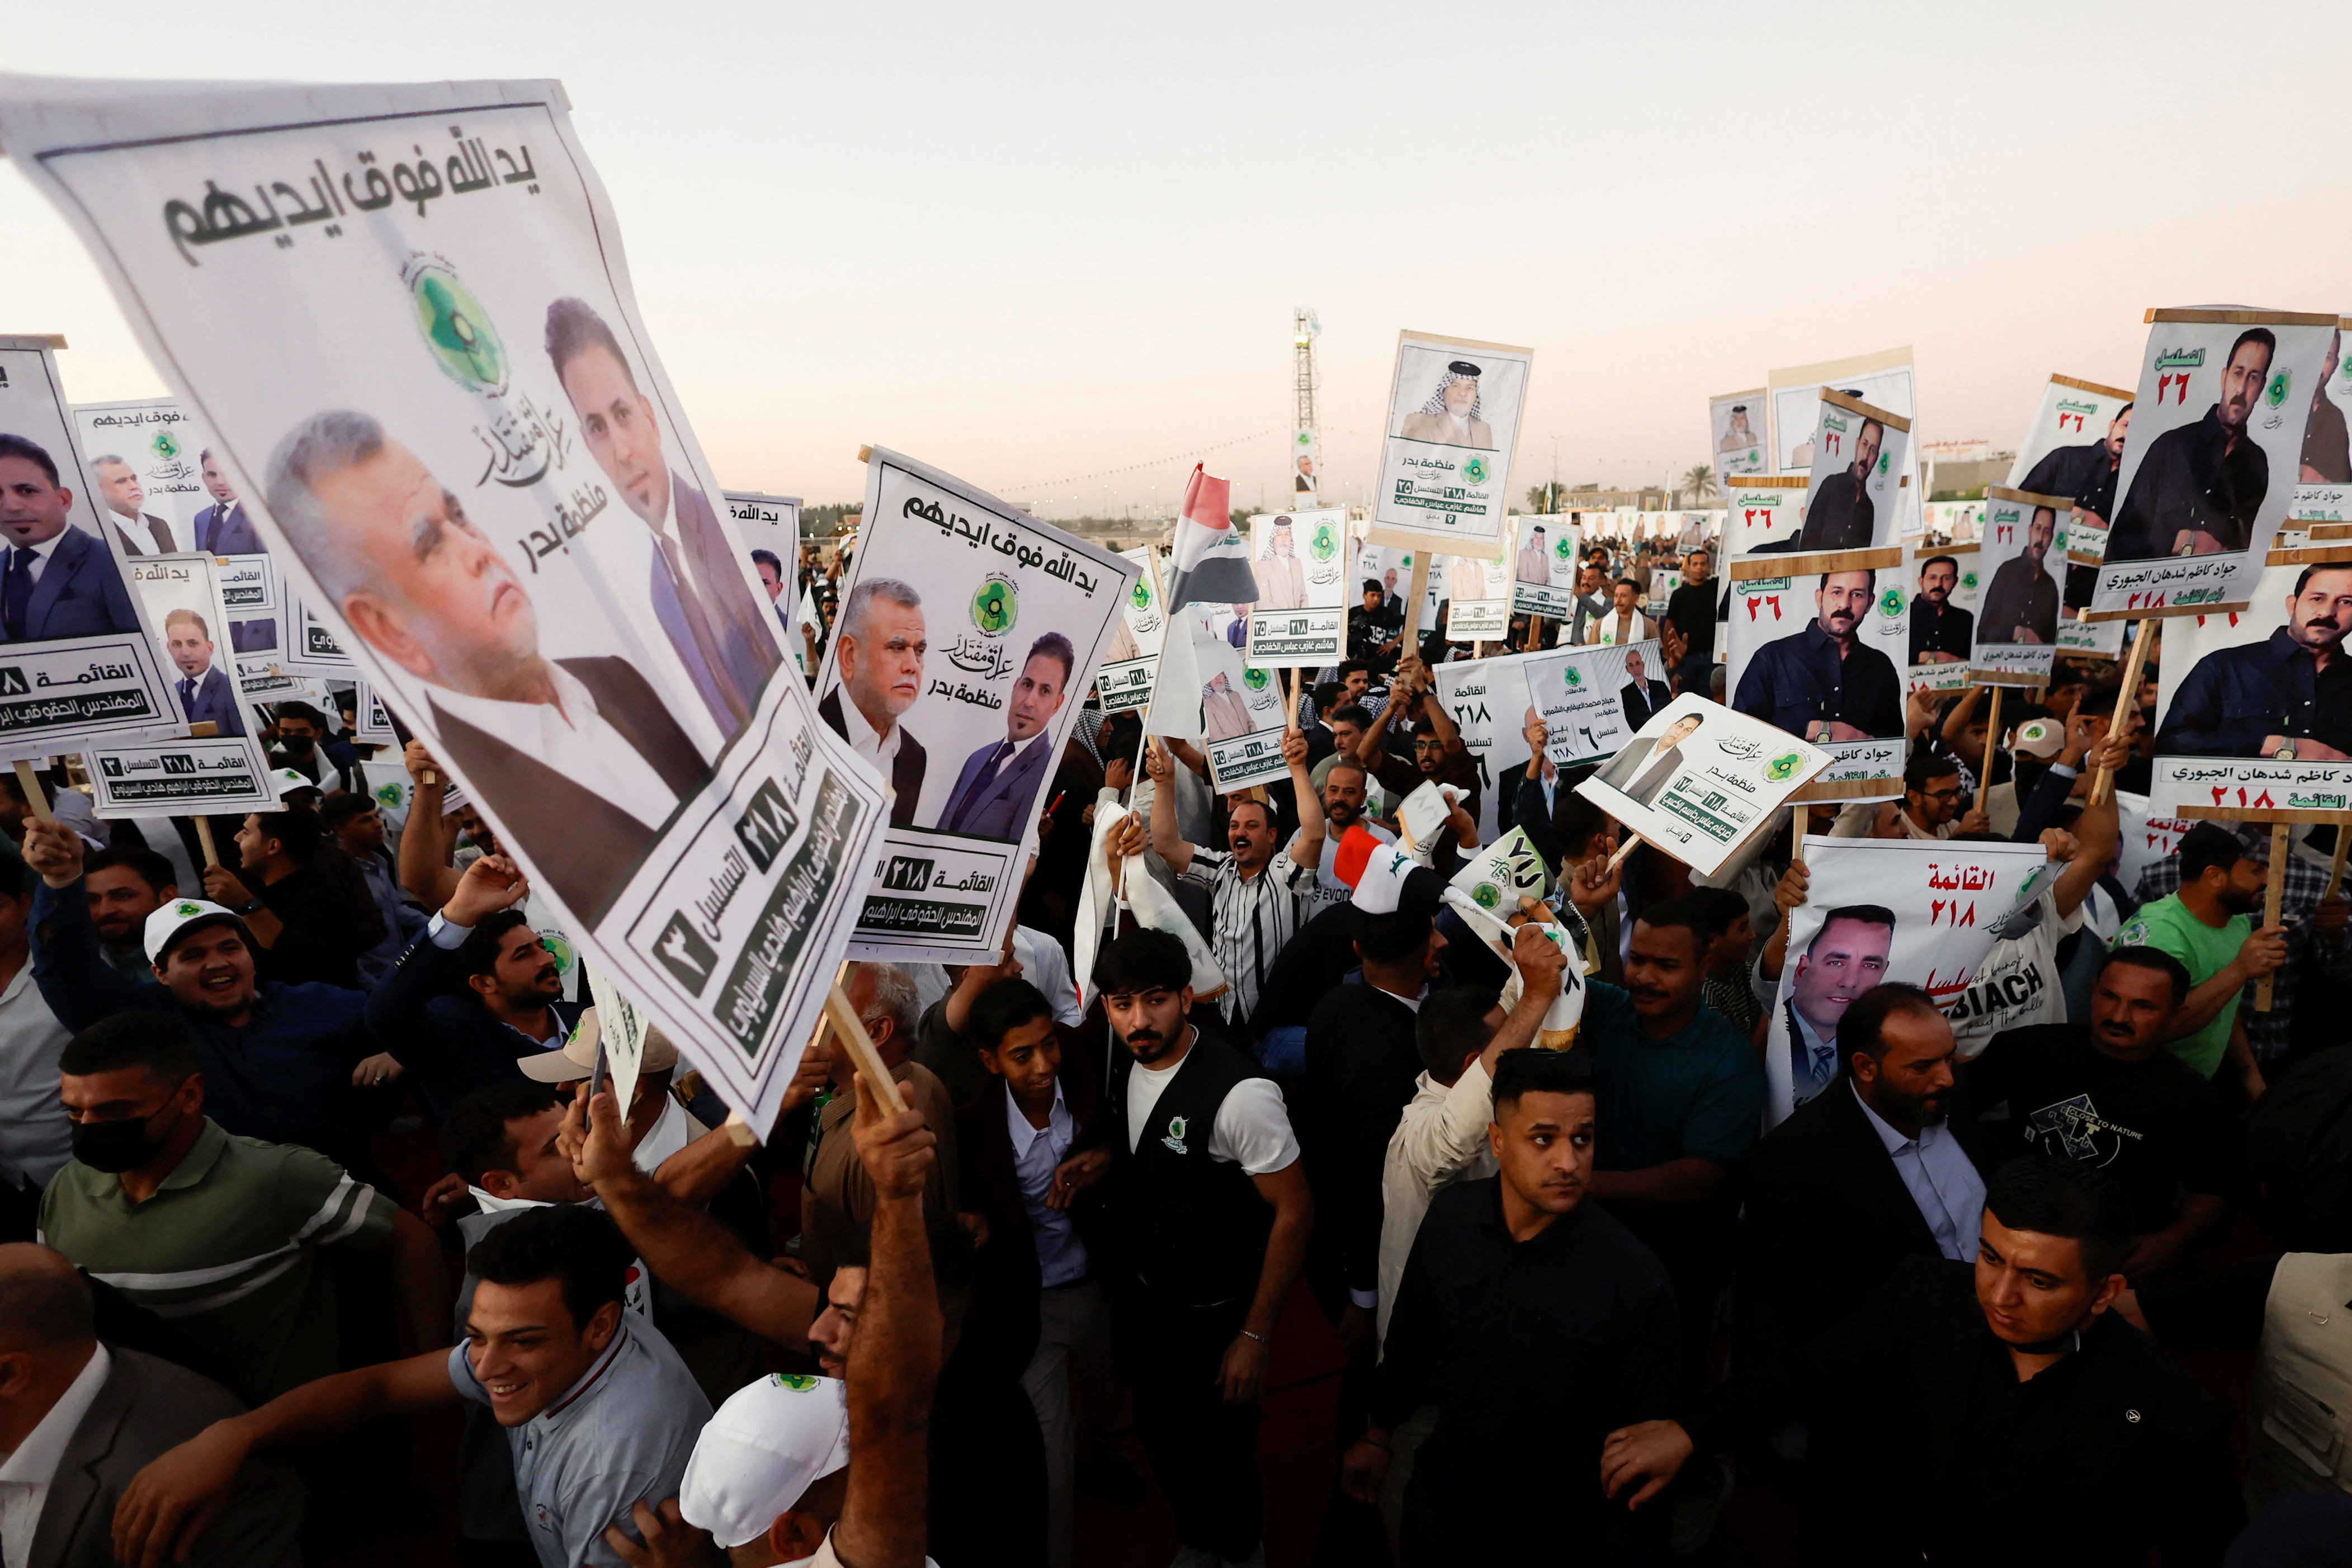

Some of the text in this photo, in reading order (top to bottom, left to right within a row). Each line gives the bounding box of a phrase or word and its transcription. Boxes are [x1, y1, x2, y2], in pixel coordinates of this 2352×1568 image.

[164, 126, 540, 267] يد الله فوق ايديهم
[2157, 372, 2191, 407] ٢٦
[93, 412, 180, 427] فوق ايديهم
[2060, 413, 2084, 433] ٢٦
[1826, 431, 1840, 458] ٢٦
[1401, 457, 1455, 470] منظمة بدر
[149, 485, 163, 495] بدر
[1398, 480, 1489, 500] القائمة ٢١٨ التسلسل ٢٥
[739, 504, 759, 519] الله
[1395, 497, 1485, 513] هاشم غازي عباس الخفاجي
[762, 513, 778, 525] يد
[903, 497, 991, 549] ايديهم
[1745, 509, 1772, 530] ٢٦
[518, 483, 608, 574] منظمة بدر
[991, 532, 1043, 568] فوق
[146, 564, 168, 579] الله
[172, 569, 190, 582] يد
[1043, 551, 1076, 583] الله
[2107, 561, 2237, 591] جواد كاظم شدهان الجبوري
[1075, 572, 1098, 598] يد
[1428, 591, 1436, 607] ٦
[2172, 588, 2209, 606] القائمة
[1747, 595, 1782, 622] ٢٦
[1255, 620, 1338, 636] القائمة ٢١٨ التسلسل ٢٥
[1254, 639, 1335, 654] هاشم غازي عباس الخفاجي
[37, 664, 134, 687] القائمة
[1100, 677, 1110, 690] ٢٥
[1112, 676, 1129, 689] التسلسل
[1131, 671, 1145, 684] ٢١٨
[927, 679, 1002, 710] منظمة بدر
[1105, 692, 1142, 707] عباس الخفاجي
[1455, 685, 1486, 697] القائمة
[82, 692, 145, 716] المهندس
[1585, 700, 1601, 709] محمد
[1602, 697, 1616, 706] صباح
[15, 700, 81, 723] الحقوقي
[1454, 702, 1491, 725] ٢١٨
[1543, 706, 1564, 717] الشمري
[1466, 738, 1492, 747] تسلس
[1579, 726, 1599, 750] ٦
[1597, 728, 1618, 739] تسلسل
[1214, 752, 1225, 763] ٢٥
[1227, 749, 1245, 762] التسلسل
[1246, 743, 1262, 757] ٢١٨
[1553, 747, 1575, 759] ٢١٨
[1864, 748, 1893, 762] جواد
[104, 756, 245, 774] القائمة ٢١٨ التسلسل ٣
[1219, 758, 1274, 779] غازي عباس الخفاجي
[1706, 766, 1756, 793] منظمة بدر
[2172, 767, 2235, 782] الجبوري
[2237, 768, 2292, 782] شدهان
[2296, 769, 2340, 785] كاظم
[142, 782, 167, 795] هادي
[1686, 784, 1708, 799] التسلسل
[2211, 786, 2275, 809] ٢١٨
[821, 774, 849, 842] المهندس
[1705, 793, 1723, 811] ٢١٨
[2288, 793, 2346, 809] القائمة
[1662, 795, 1733, 839] ضرغام عباس جاسم الكعبي
[1721, 805, 1750, 824] القائمة
[662, 726, 813, 977] القائمة ٢١٨ التسلسل ٣
[808, 820, 833, 886] الحقوقي
[891, 859, 925, 889] ٢١٨
[933, 870, 995, 892] القائمة
[1929, 864, 1995, 891] القائمة
[783, 864, 819, 932] ابراهيم
[863, 902, 984, 929] المهندس الحقوقي ابراهيم
[1931, 899, 1975, 928] ٢١٨
[762, 913, 791, 973] هادي
[2069, 1108, 2143, 1141] CLOSE TO NATURE
